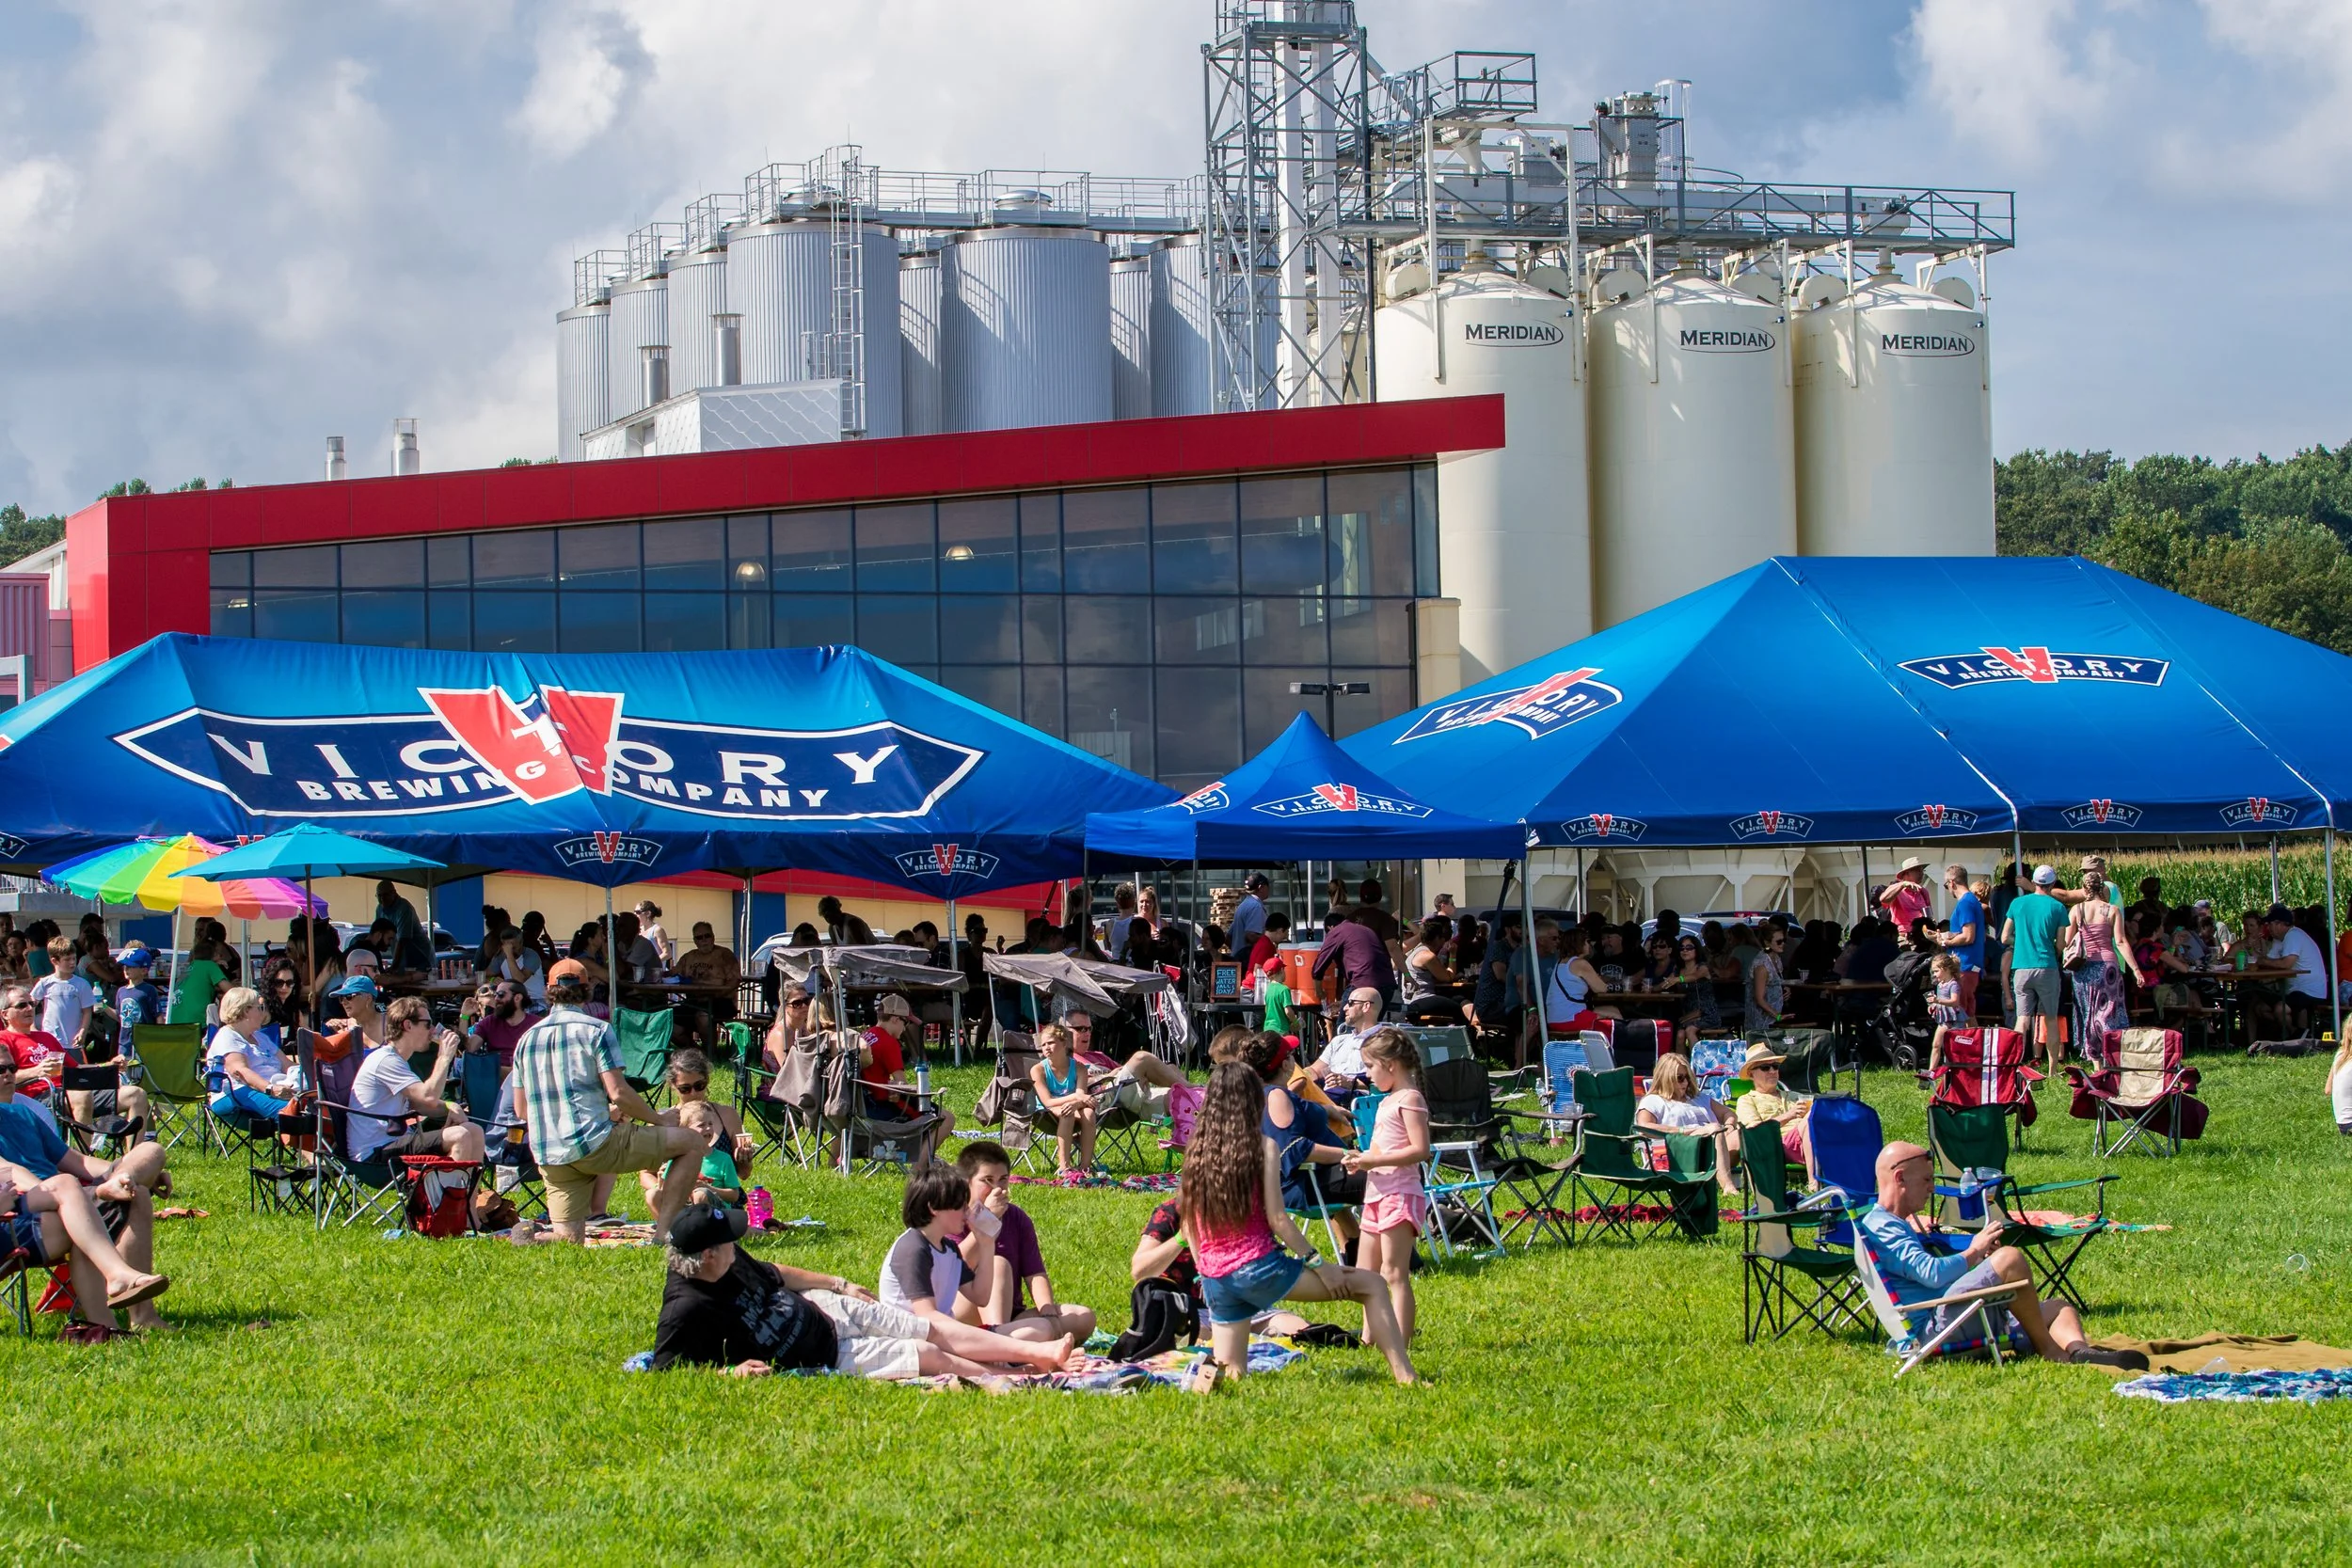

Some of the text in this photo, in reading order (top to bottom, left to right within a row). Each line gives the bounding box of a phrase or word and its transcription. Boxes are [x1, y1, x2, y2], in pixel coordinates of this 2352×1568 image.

[1465, 324, 1555, 341] MERIDIAN
[1680, 330, 1769, 348] MERIDIAN
[1882, 334, 1968, 352] MERIDIAN
[1925, 657, 2143, 675] VICTORY
[1958, 669, 2125, 680] BREWING COMPANY
[1436, 686, 1600, 722] VICTORY
[207, 712, 900, 786] VICTORY
[296, 754, 829, 807] BREWING COMPANY
[1270, 789, 1416, 813] VICTORY
[1291, 800, 1404, 813] BREWING COMPANY
[2069, 806, 2135, 818] VICTORY
[2227, 805, 2291, 817] VICTORY
[1738, 816, 1805, 831] VICTORY
[1902, 812, 1970, 825] VICTORY
[1569, 819, 1639, 832] VICTORY
[1578, 827, 1630, 835] BREWING COMPANY
[1745, 824, 1771, 833] BREWING
[564, 842, 652, 855] VICTORY
[576, 850, 643, 859] BREWING COMPANY
[904, 854, 989, 867] VICTORY
[914, 863, 979, 871] BREWING COMPANY
